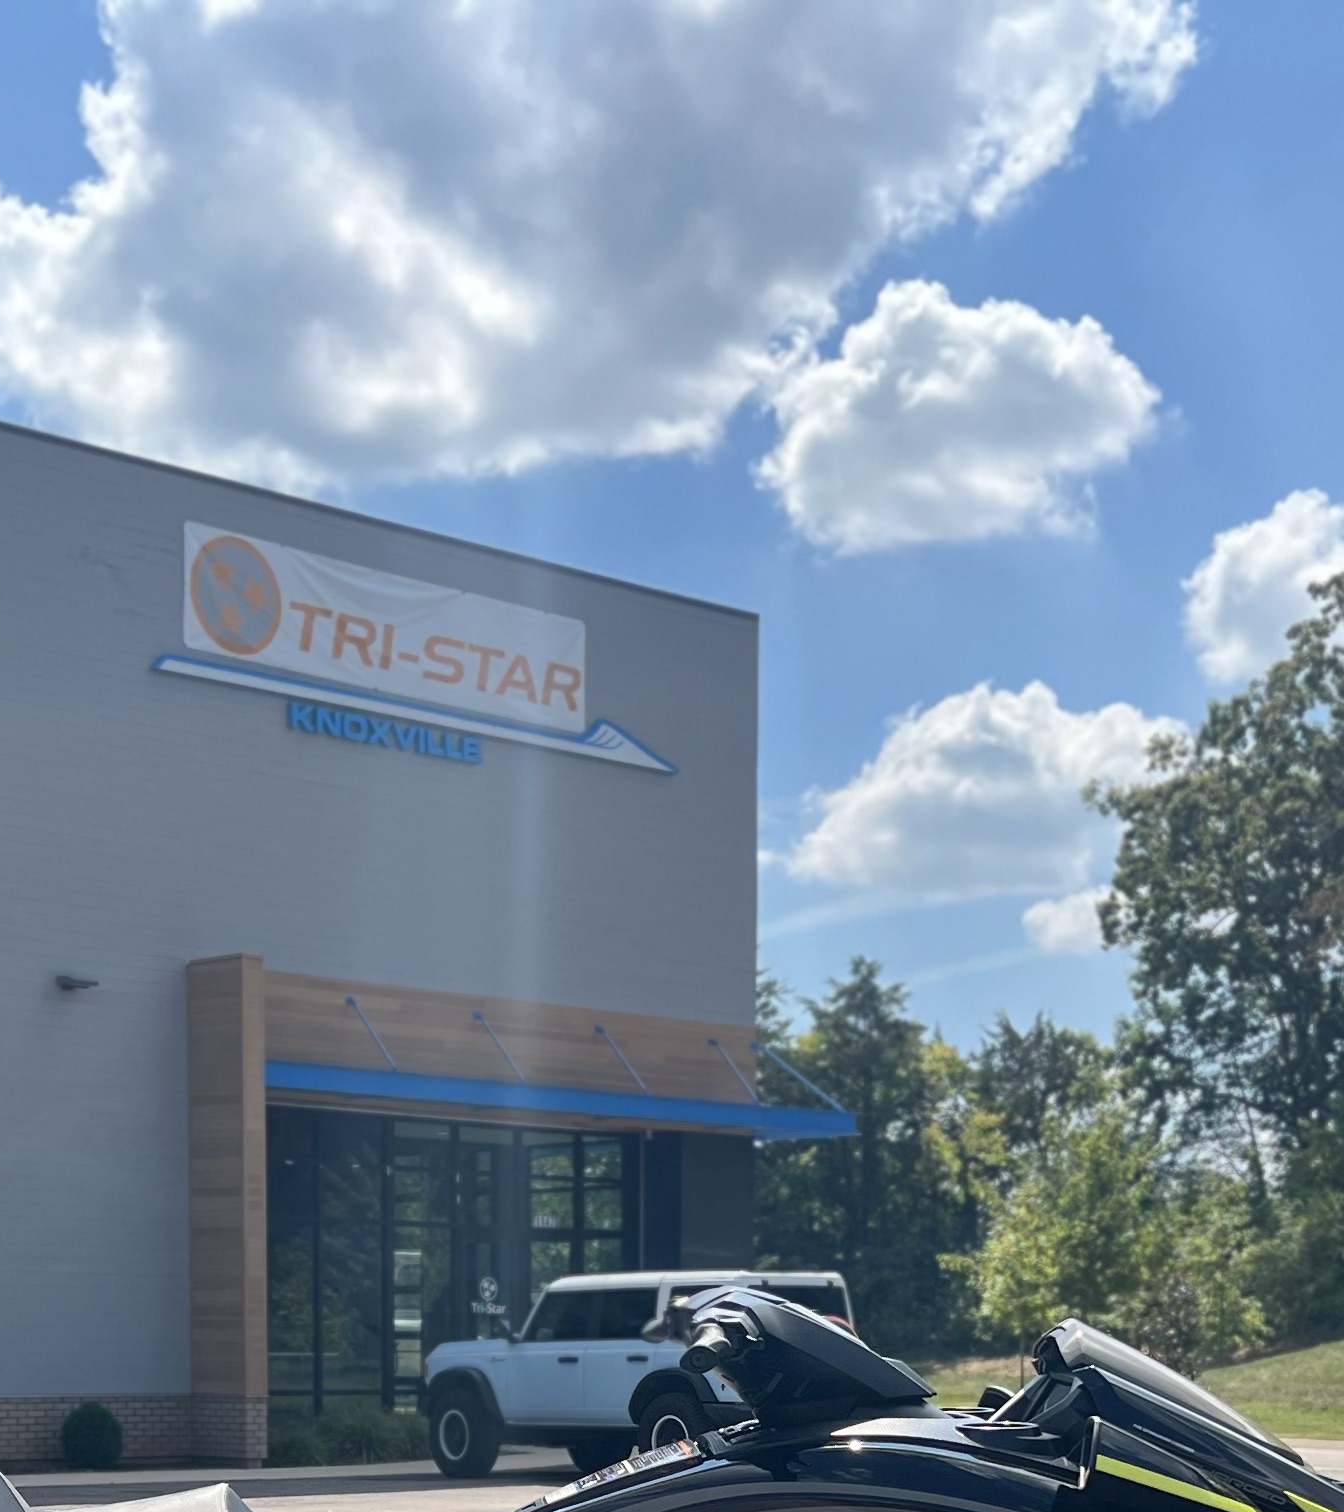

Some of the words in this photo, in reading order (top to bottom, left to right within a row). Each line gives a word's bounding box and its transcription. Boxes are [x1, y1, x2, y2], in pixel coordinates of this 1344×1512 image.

[289, 600, 582, 713] TRI-STAR
[289, 702, 484, 765] KNOXVILLE
[470, 1302, 506, 1314] Tri-Star
